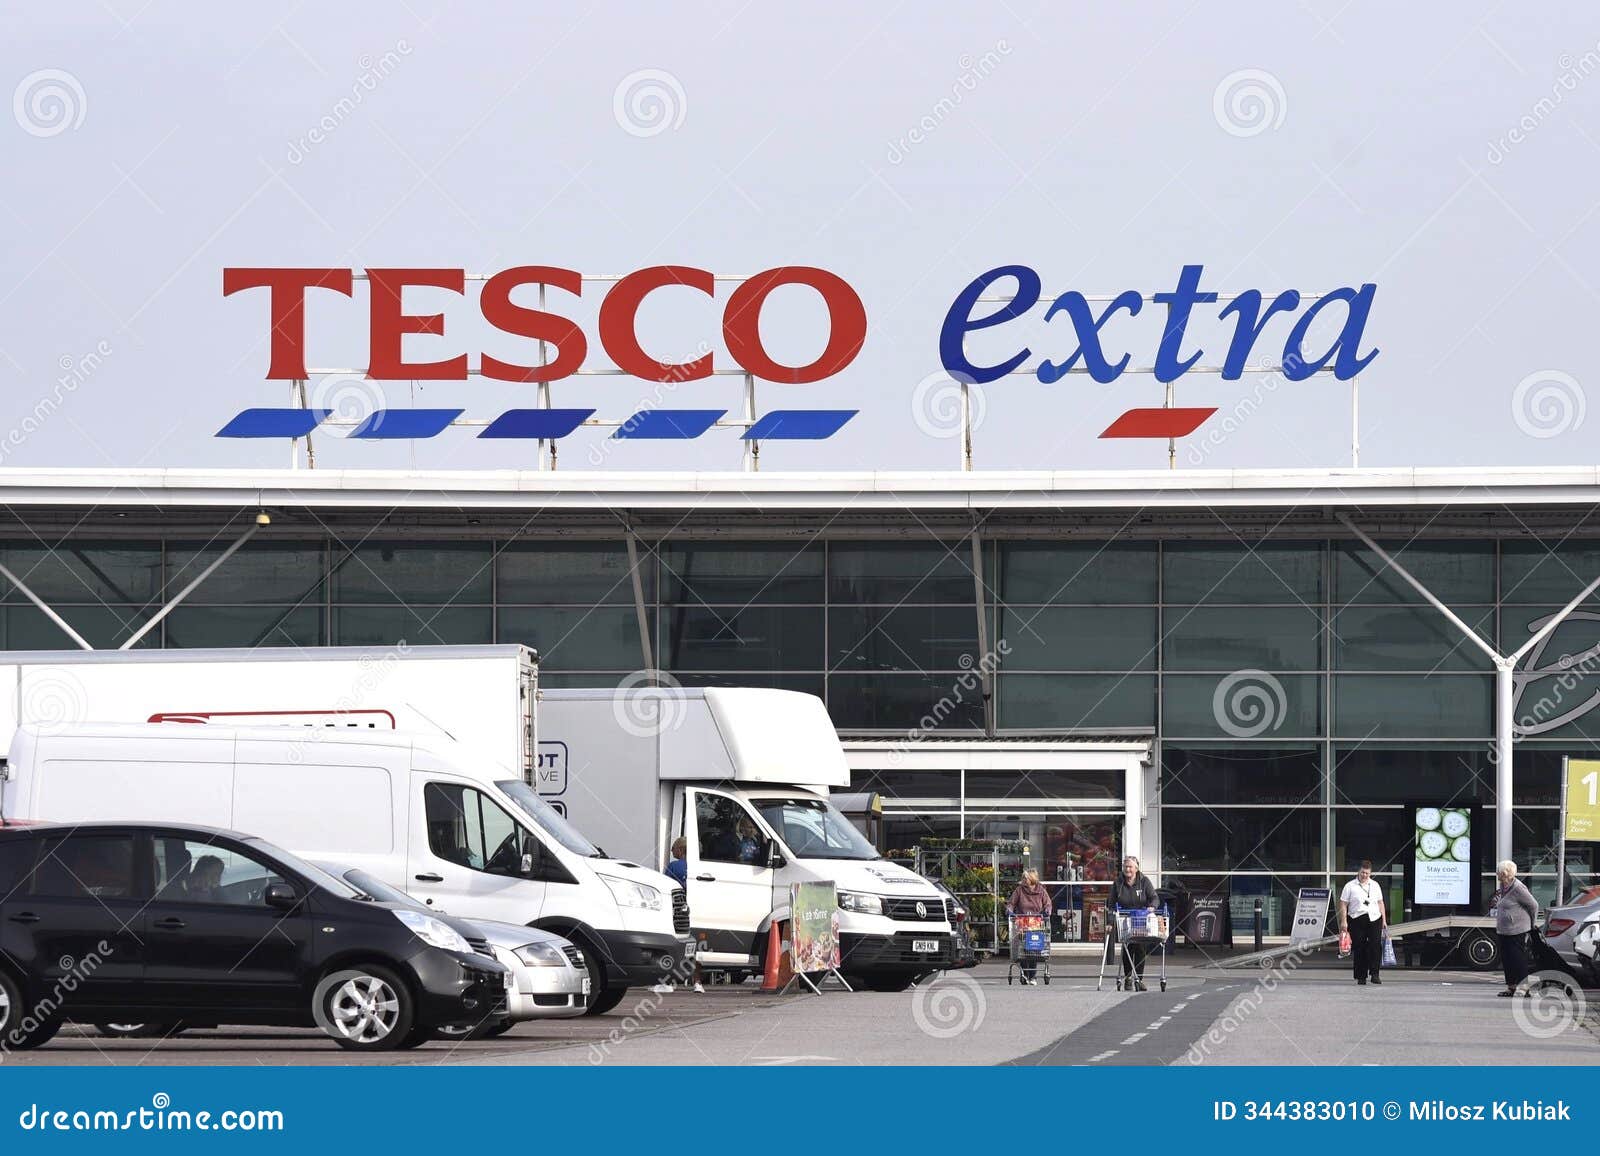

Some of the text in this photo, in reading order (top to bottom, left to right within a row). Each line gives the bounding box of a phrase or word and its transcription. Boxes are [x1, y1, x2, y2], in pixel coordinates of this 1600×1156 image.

[223, 265, 1380, 384] TESCO extra
[1581, 771, 1598, 806] 1
[1426, 865, 1441, 874] Stay
